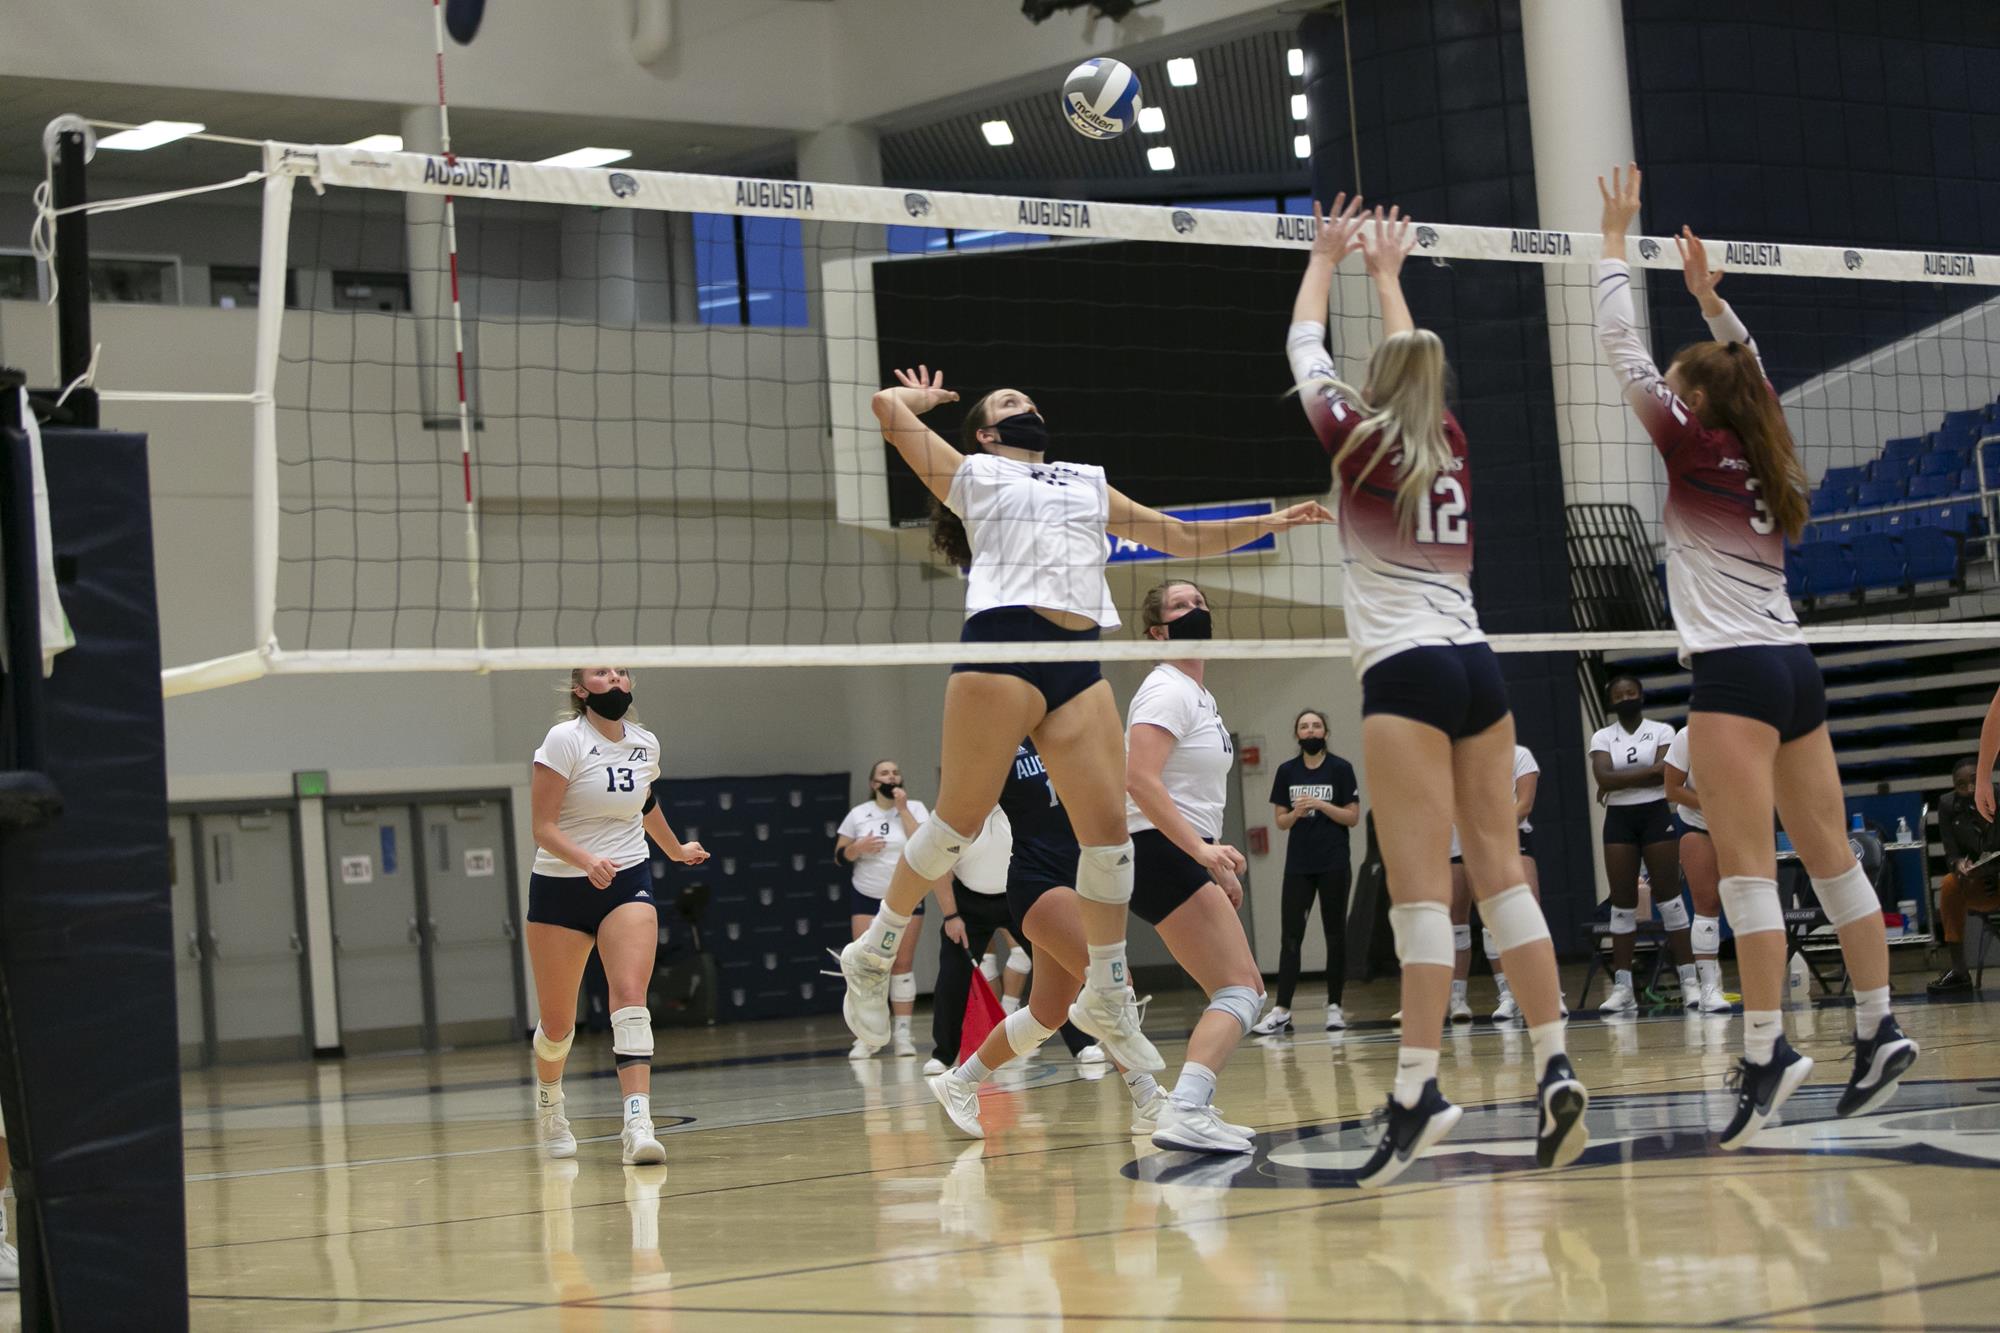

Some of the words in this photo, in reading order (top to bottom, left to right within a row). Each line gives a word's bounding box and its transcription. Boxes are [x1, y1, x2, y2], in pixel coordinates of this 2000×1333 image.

[1075, 101, 1115, 130] molten
[424, 157, 511, 190] AUGUSTA
[736, 181, 814, 210] AUGUSTA
[1018, 200, 1091, 228] AUGUSTA
[1275, 217, 1318, 241] AUGU
[1511, 231, 1572, 255] AUGUSTA
[1725, 243, 1782, 266] AUGUSTA
[1923, 254, 1975, 276] AUGUSTA
[1416, 476, 1468, 544] 12
[1745, 478, 1775, 534] 3
[1626, 747, 1638, 764] 2
[606, 767, 634, 792] 13
[880, 822, 889, 835] 9
